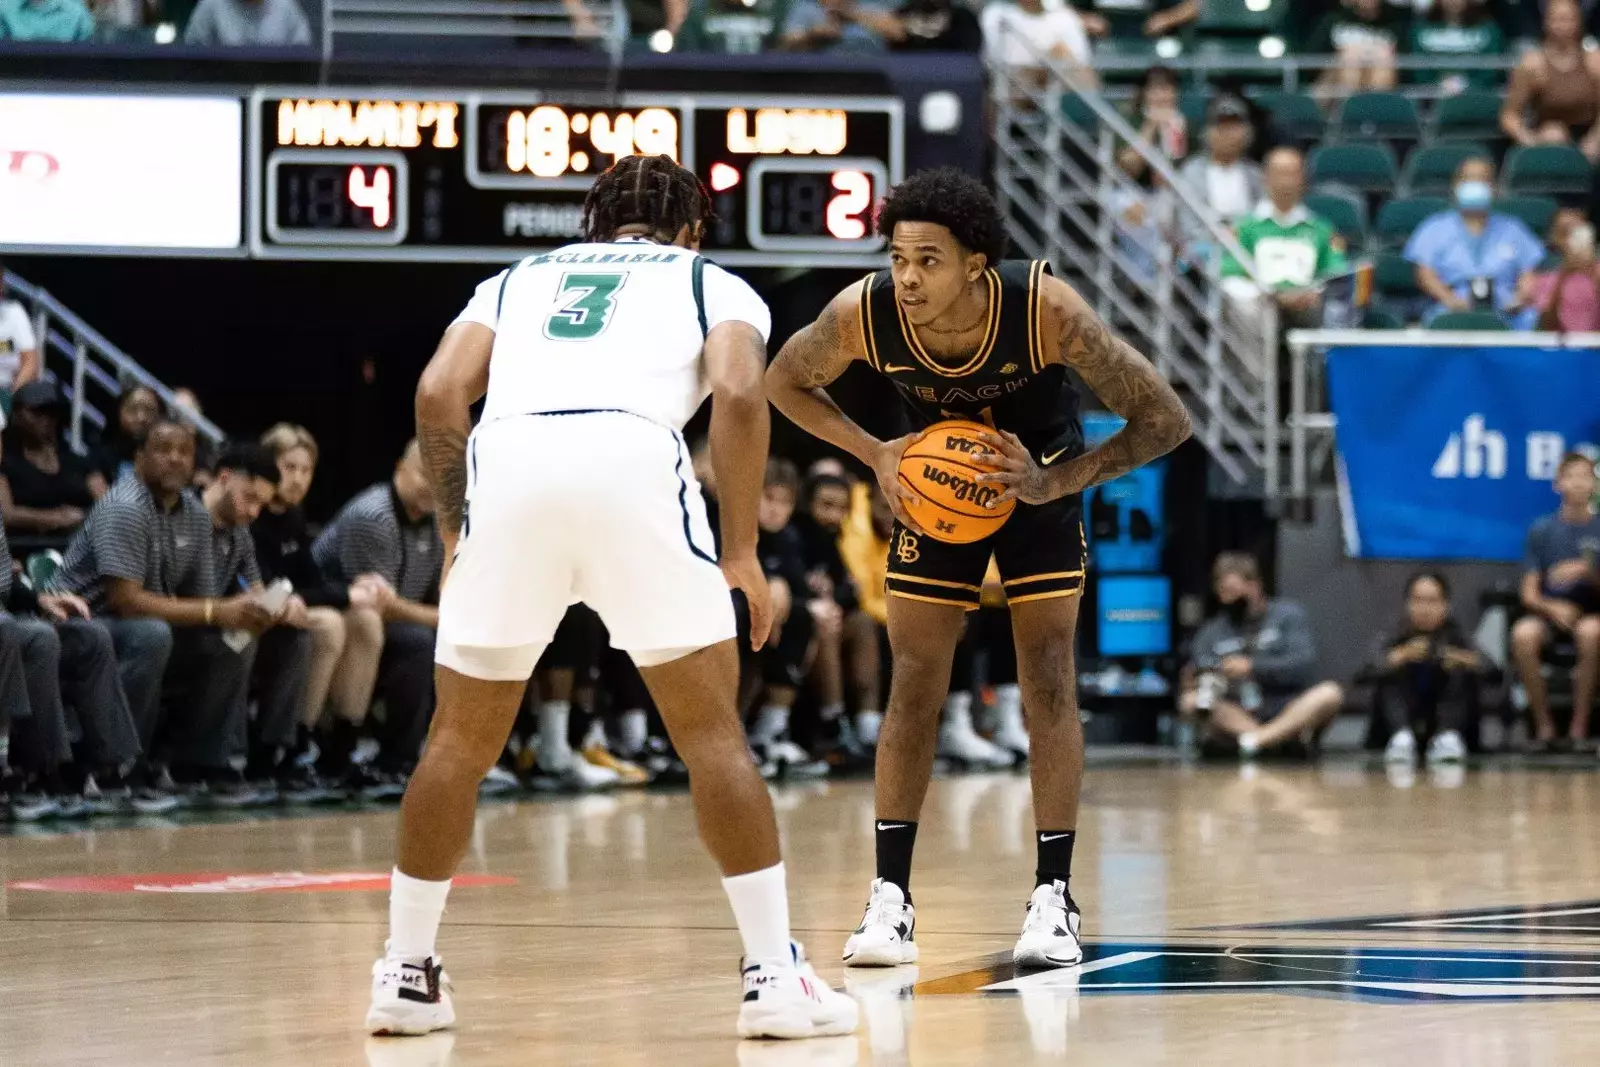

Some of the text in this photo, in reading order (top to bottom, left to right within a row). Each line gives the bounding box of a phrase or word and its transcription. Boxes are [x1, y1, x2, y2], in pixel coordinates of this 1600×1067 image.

[507, 105, 677, 177] 18:49
[349, 166, 390, 227] 4
[503, 202, 585, 237] PERIO
[826, 169, 871, 239] 2
[542, 271, 631, 342] 3
